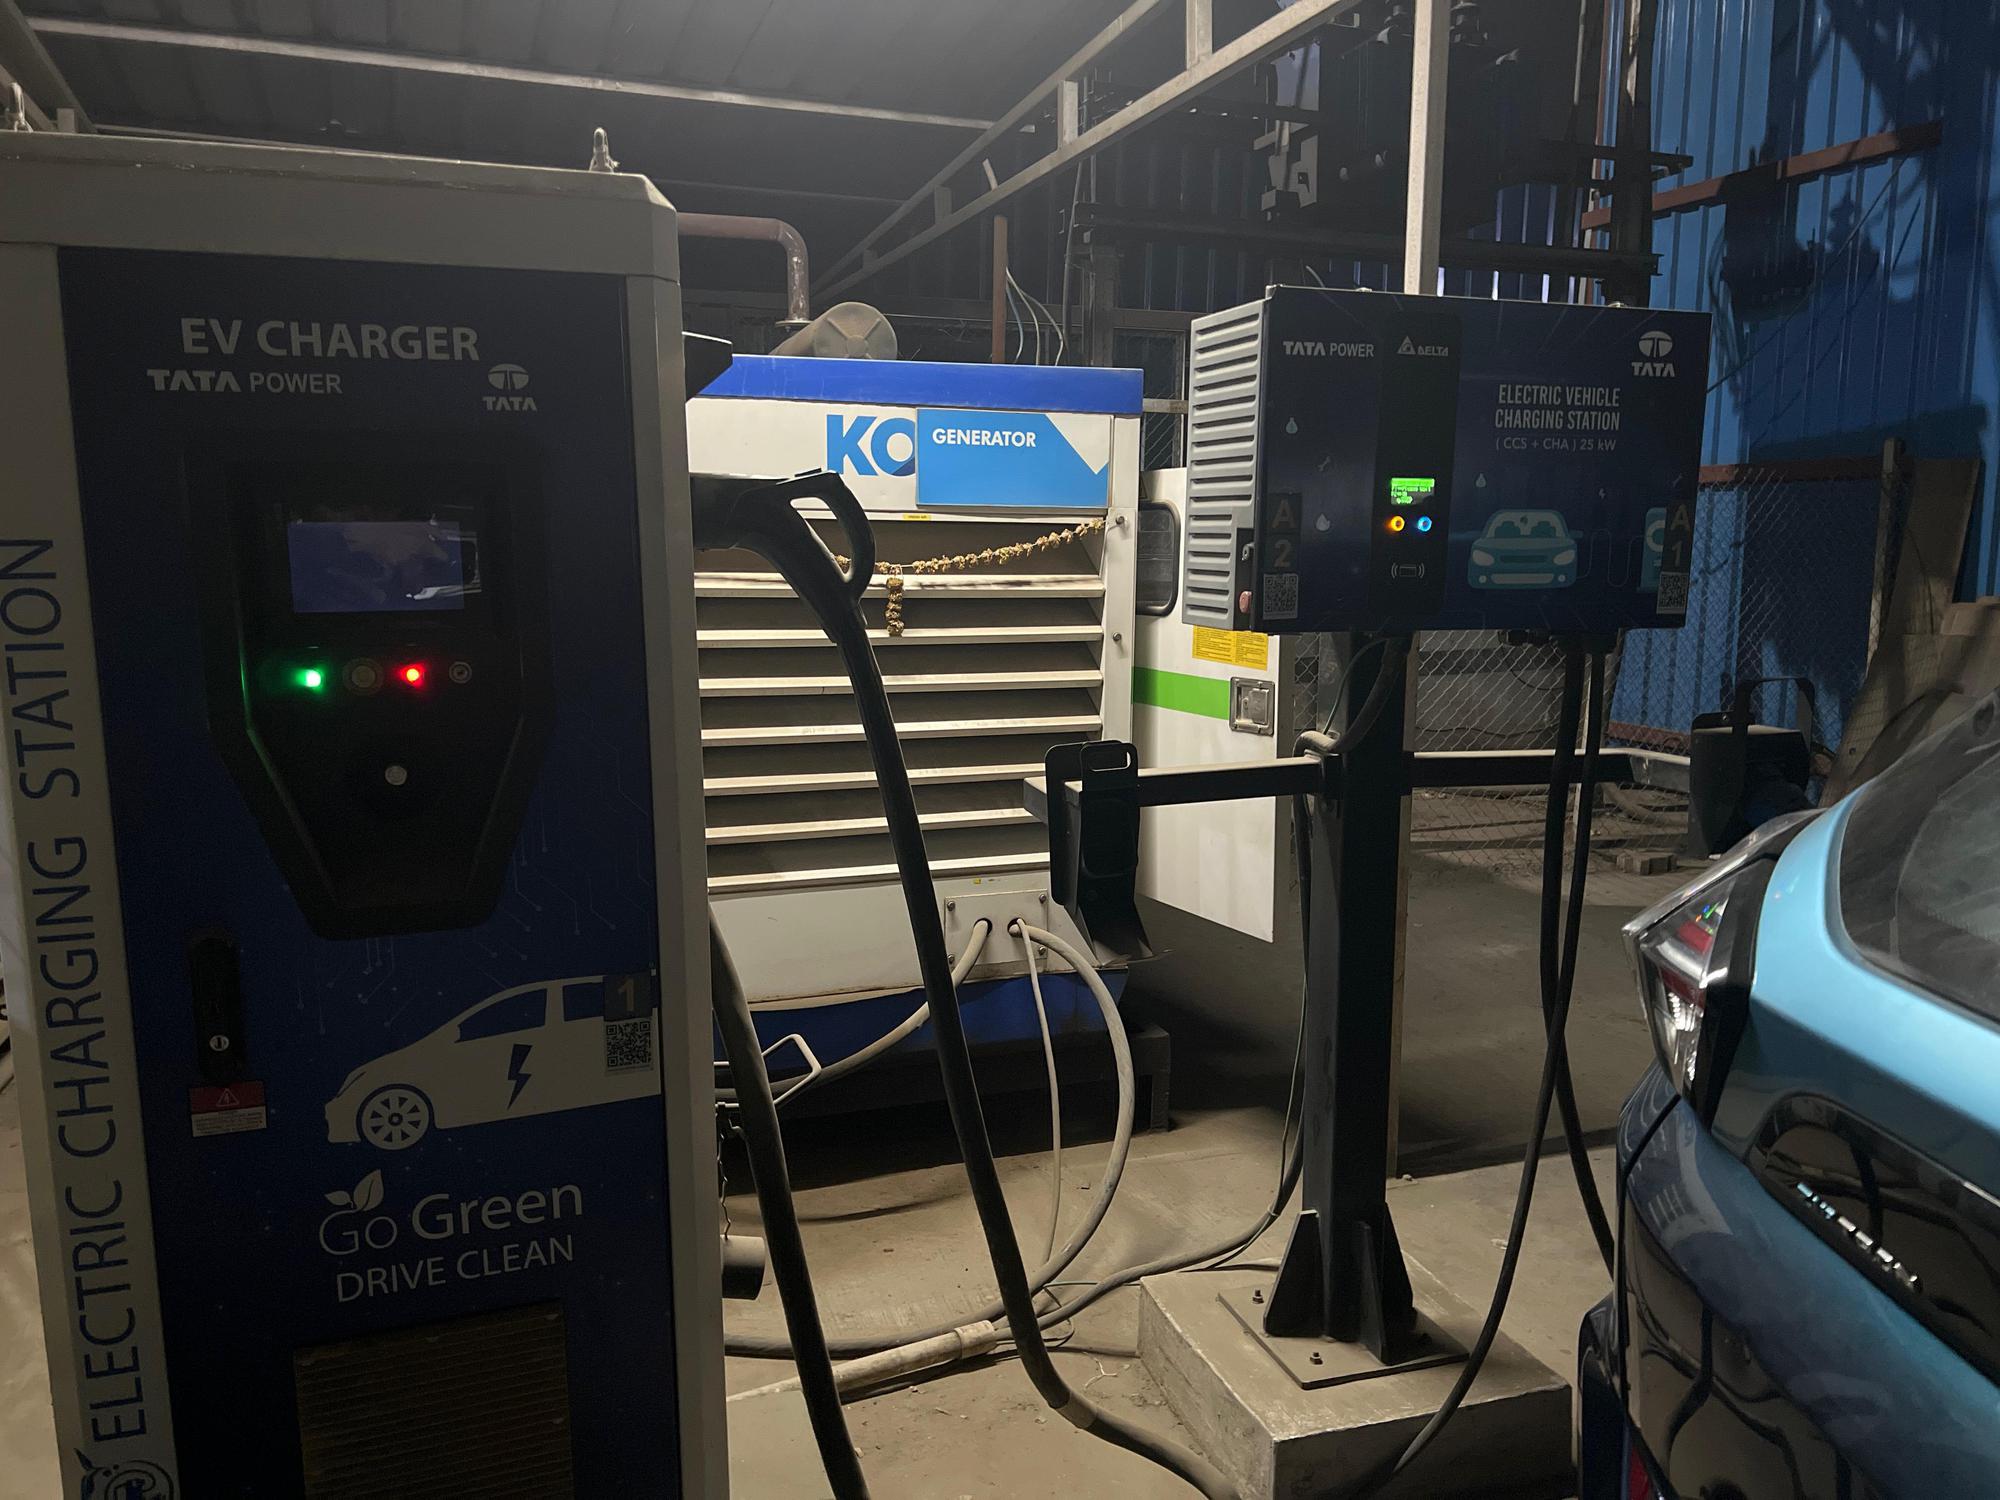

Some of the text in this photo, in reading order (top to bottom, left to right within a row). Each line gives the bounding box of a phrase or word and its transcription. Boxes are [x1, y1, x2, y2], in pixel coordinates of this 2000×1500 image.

[181, 318, 479, 361] EV CHARGER
[1283, 340, 1374, 358] TATA POWER
[1417, 345, 1449, 357] DELTA
[147, 368, 343, 394] TATA POWER
[1631, 362, 1676, 378] TATA
[483, 396, 537, 411] TATA
[1498, 384, 1621, 407] ELECTRIC VEHICLE
[1495, 408, 1620, 431] CHARGING STATION
[932, 428, 1036, 448] GENERATOR
[1503, 437, 1527, 450] CCS
[1542, 437, 1569, 450] CHA
[1580, 439, 1594, 450] 25
[1597, 439, 1617, 451] kW
[1271, 498, 1296, 529] A
[1671, 503, 1691, 531] A
[1273, 539, 1292, 568] 2
[1671, 541, 1683, 567] 1
[0, 539, 147, 1441] ELECTRIC CHARGING STATION
[617, 978, 635, 1011] 1
[412, 1184, 583, 1241] Green
[336, 1234, 574, 1303] DRIVE CLEAN
